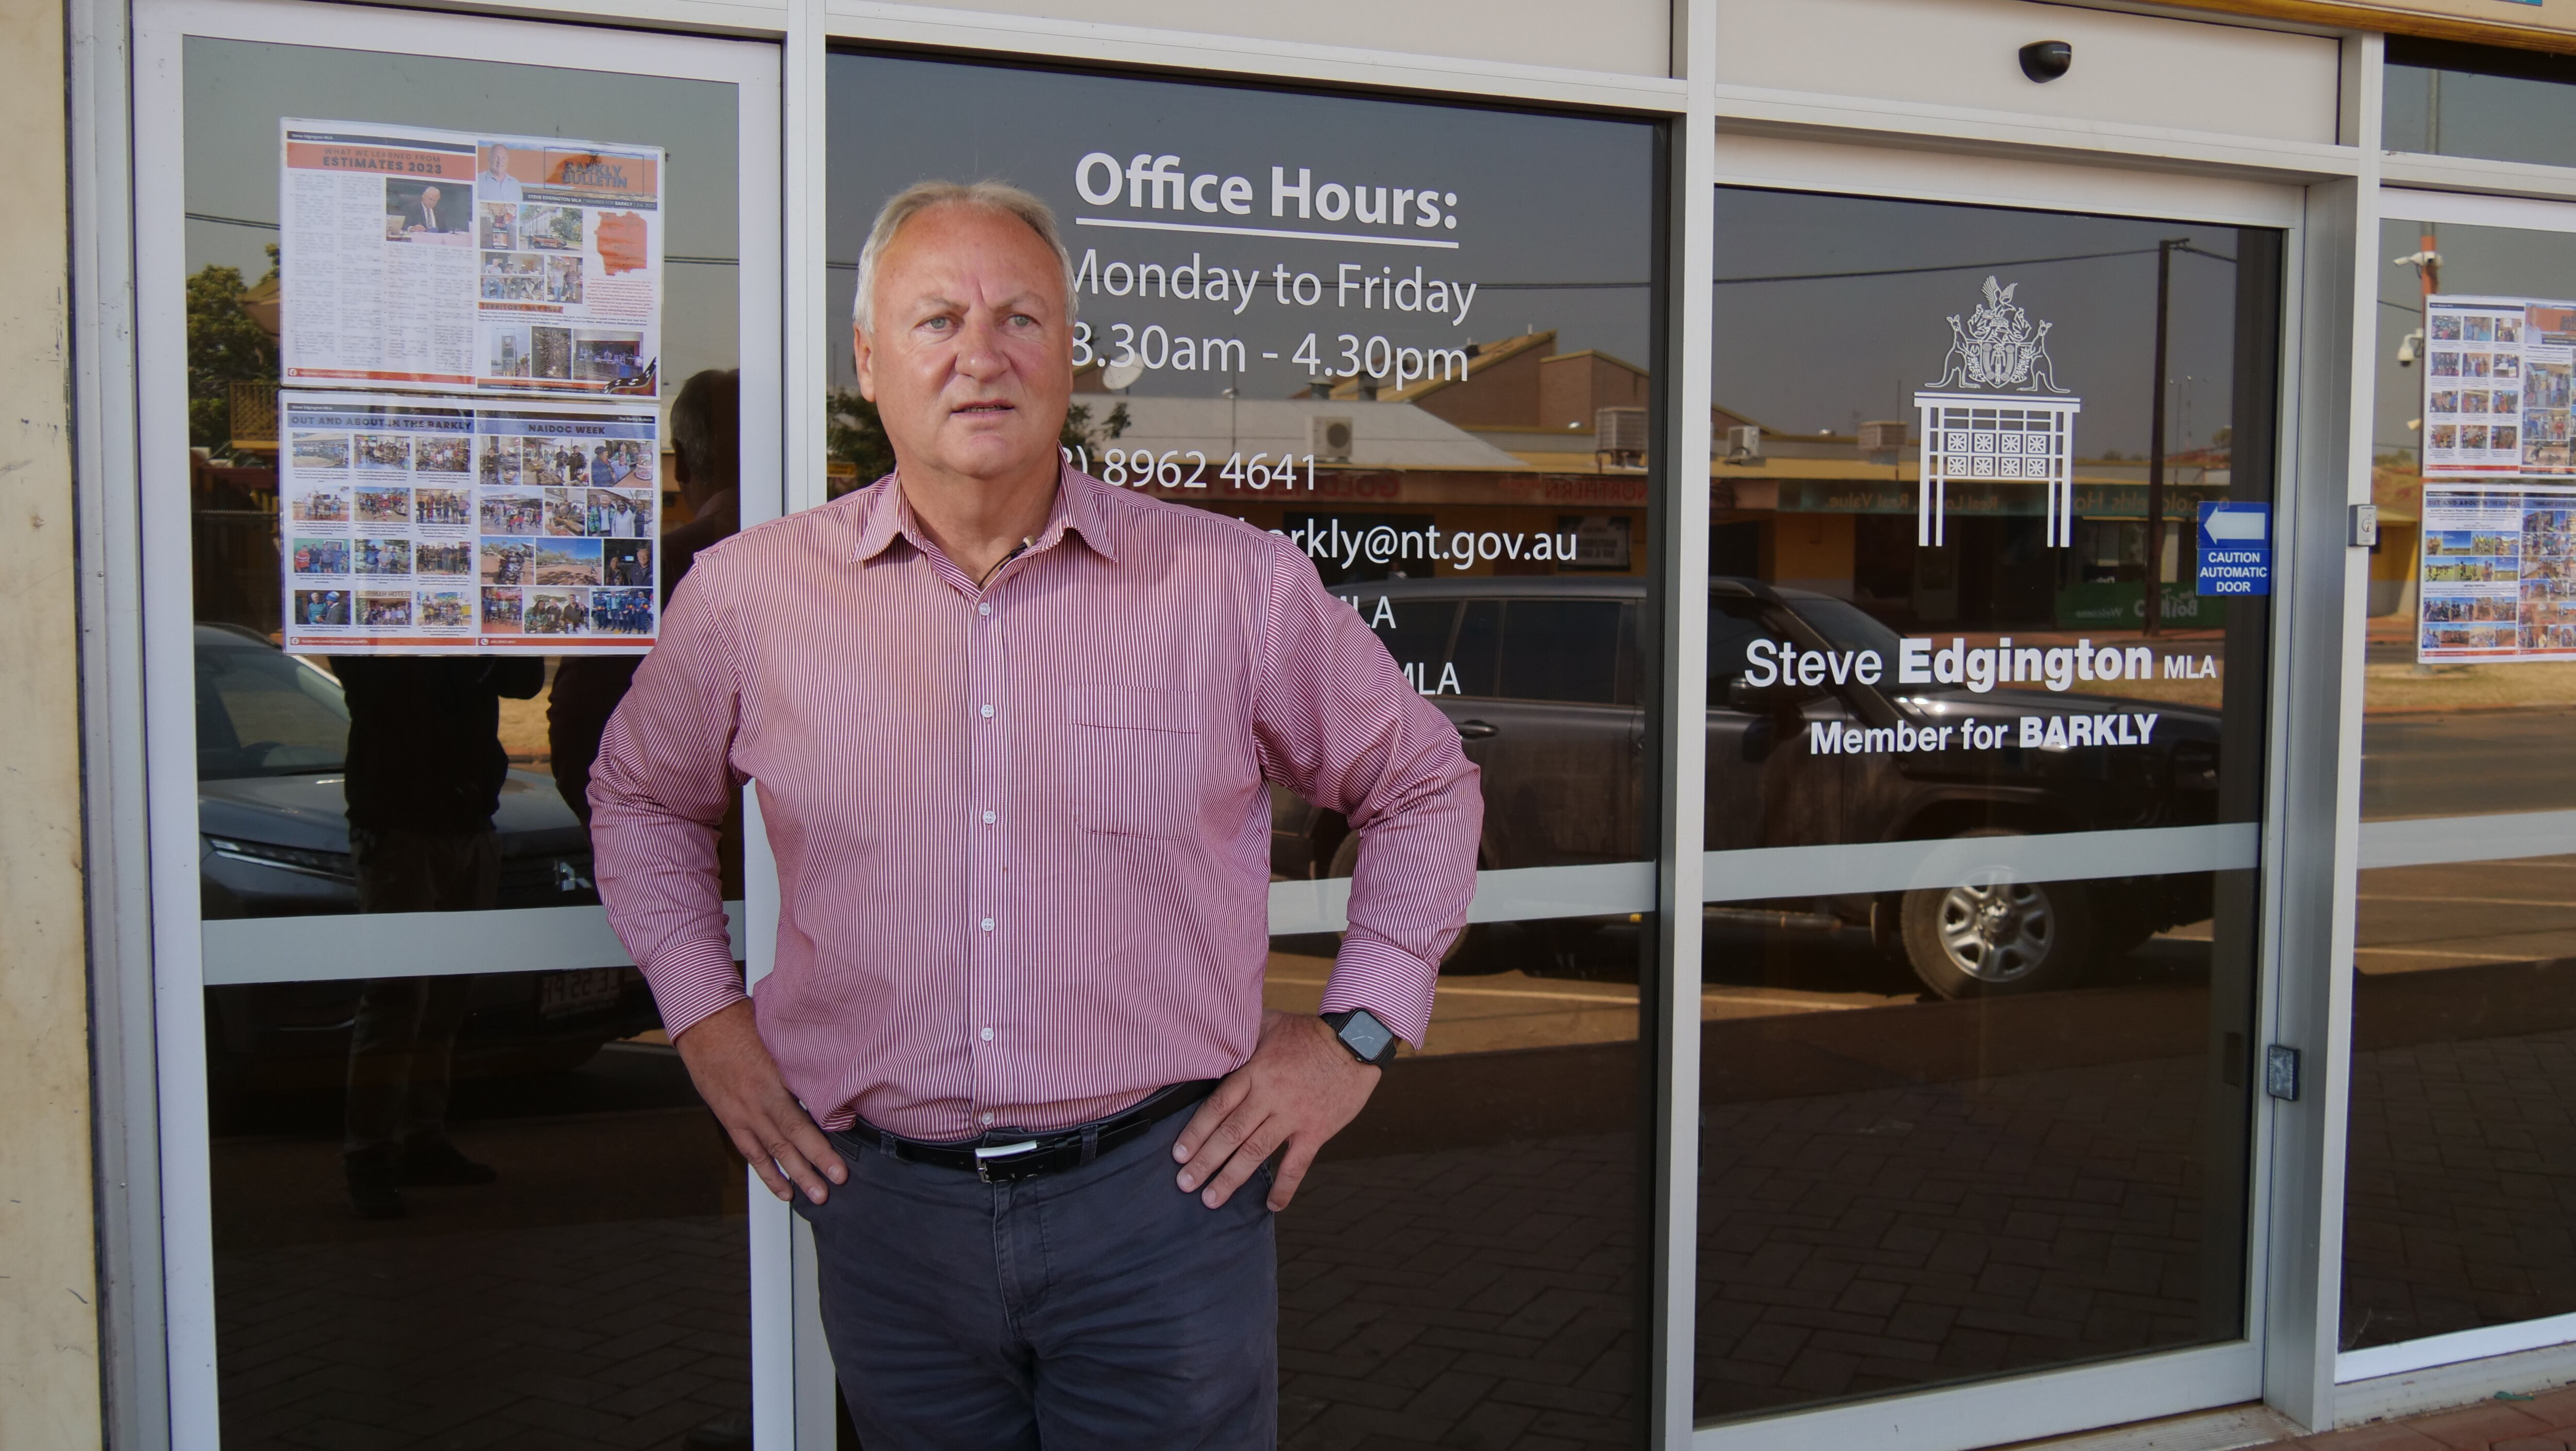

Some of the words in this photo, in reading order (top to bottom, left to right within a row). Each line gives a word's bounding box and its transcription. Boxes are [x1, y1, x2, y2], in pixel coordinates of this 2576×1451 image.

[371, 151, 412, 160] LEARNED
[415, 154, 440, 162] FROM
[323, 156, 404, 171] ESTIMATES
[409, 162, 443, 174] 2023
[564, 161, 622, 176] BARKLY
[562, 172, 627, 188] BULLETIN
[1075, 153, 1253, 215] Office
[1272, 166, 1458, 229] Hours:
[1073, 249, 1260, 315] Monday
[1273, 263, 1322, 306] to
[1338, 263, 1477, 326] Friday
[481, 302, 522, 310] TERRITORY
[1072, 322, 1246, 372] 8.30am
[1292, 333, 1468, 392] 4.30pm
[291, 416, 315, 424] OUT
[318, 417, 342, 425] AND
[346, 417, 385, 427] ABOUT
[387, 419, 400, 427] IN
[403, 419, 425, 428] THE
[427, 420, 472, 430] BARKLY
[528, 424, 572, 433] NAIDOC
[574, 426, 605, 434] WEEK
[1103, 448, 1207, 487] 8962
[1219, 452, 1314, 490] 4641
[1239, 517, 1577, 569] rkly@nt.gov.au
[2208, 552, 2260, 563] CAUTION
[2199, 567, 2267, 578] AUTOMATIC
[2216, 582, 2251, 593] DOOR
[1745, 639, 1883, 687] Steve
[1899, 637, 2152, 693] Edgington
[2164, 655, 2217, 679] MLA
[1811, 721, 1953, 754] Member
[1961, 718, 2008, 749] for
[2020, 713, 2158, 749] BARKLY
